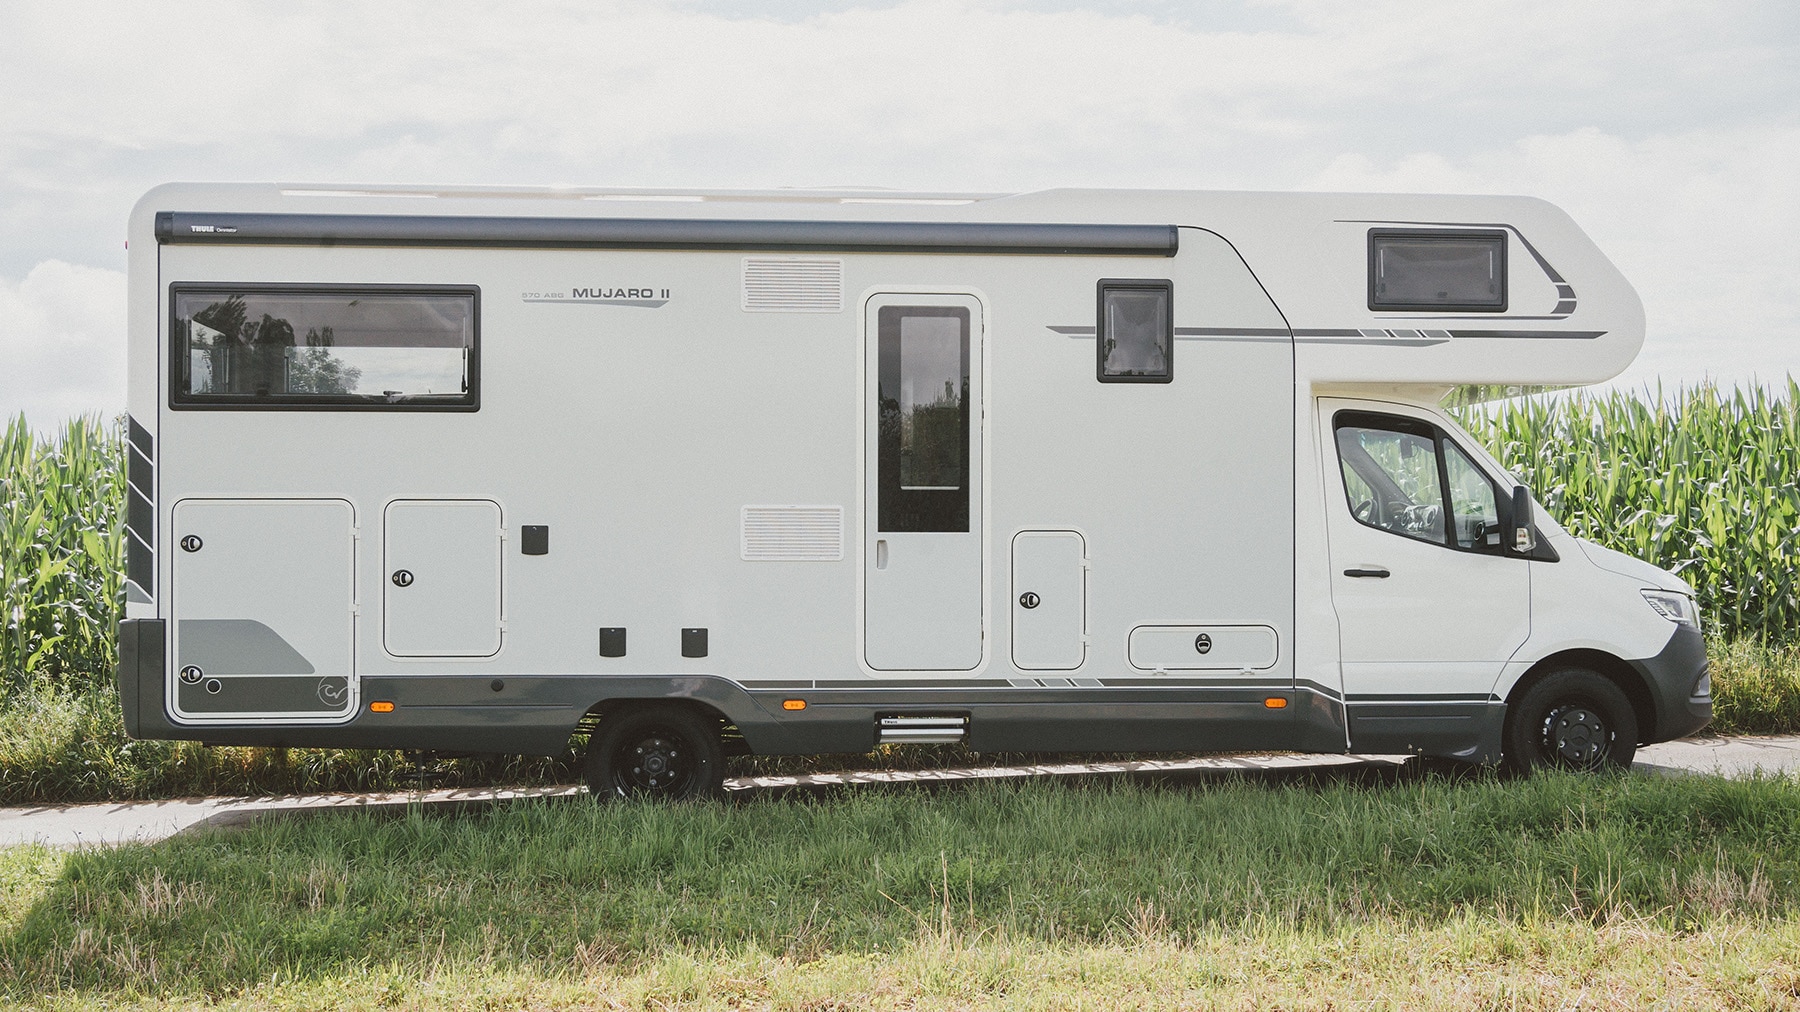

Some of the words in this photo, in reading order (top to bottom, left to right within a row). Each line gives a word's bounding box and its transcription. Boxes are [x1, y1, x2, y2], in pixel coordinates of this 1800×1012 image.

[190, 225, 215, 233] THULE
[572, 288, 653, 299] MUJARO
[661, 288, 670, 299] II
